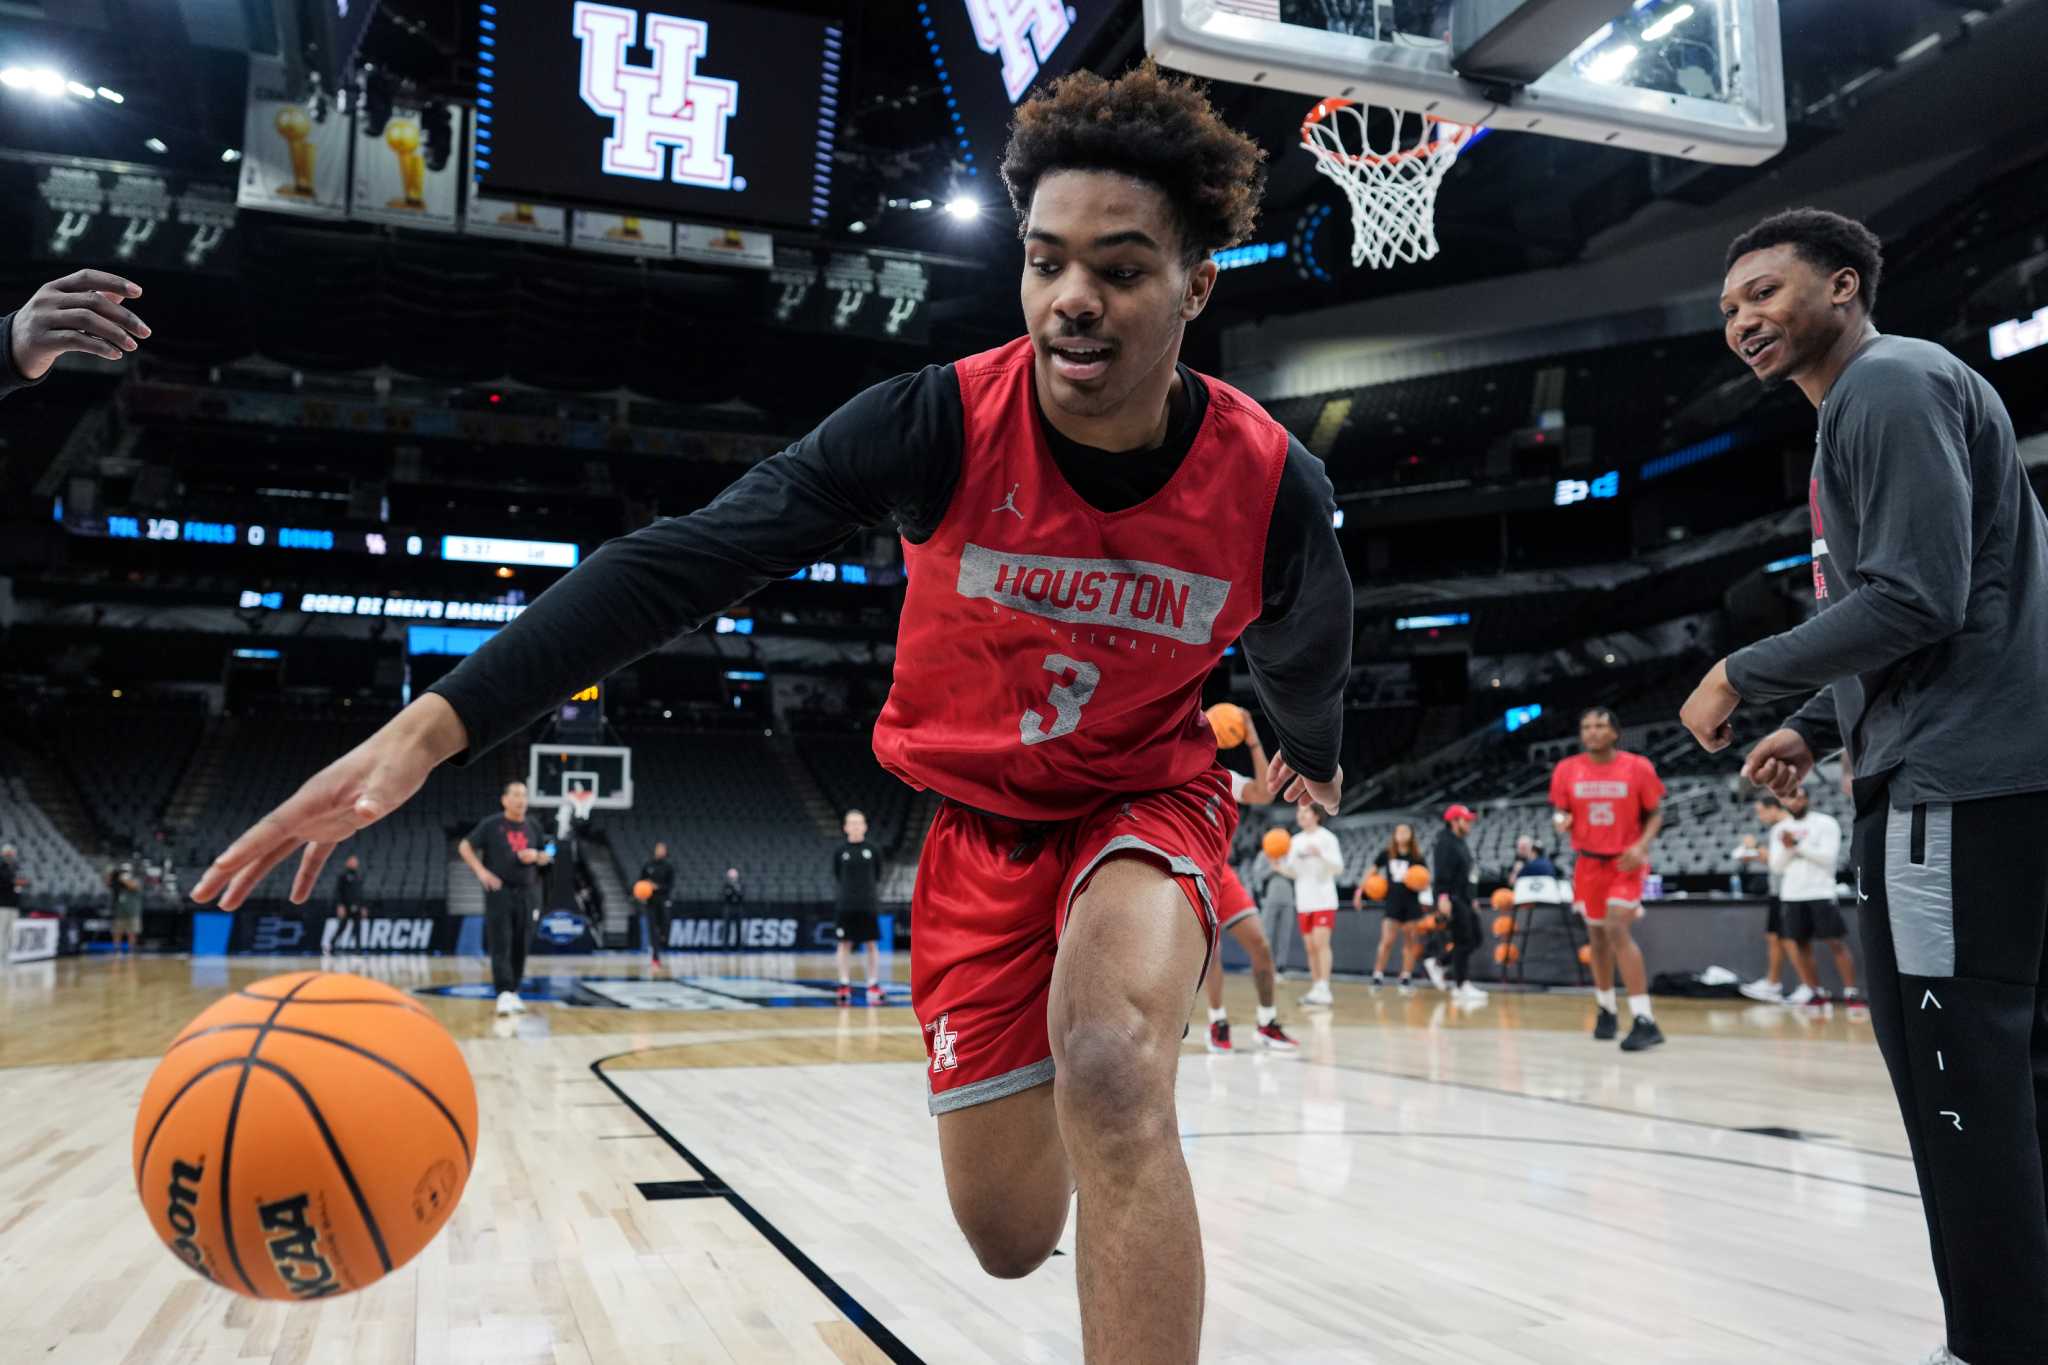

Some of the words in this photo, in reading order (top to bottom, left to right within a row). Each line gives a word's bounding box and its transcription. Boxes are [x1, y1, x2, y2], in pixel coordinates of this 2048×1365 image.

[574, 0, 738, 190] UH
[248, 525, 265, 546] 0
[384, 598, 444, 619] MEN'S
[994, 563, 1190, 630] HOUSTON
[1021, 653, 1100, 746] 3
